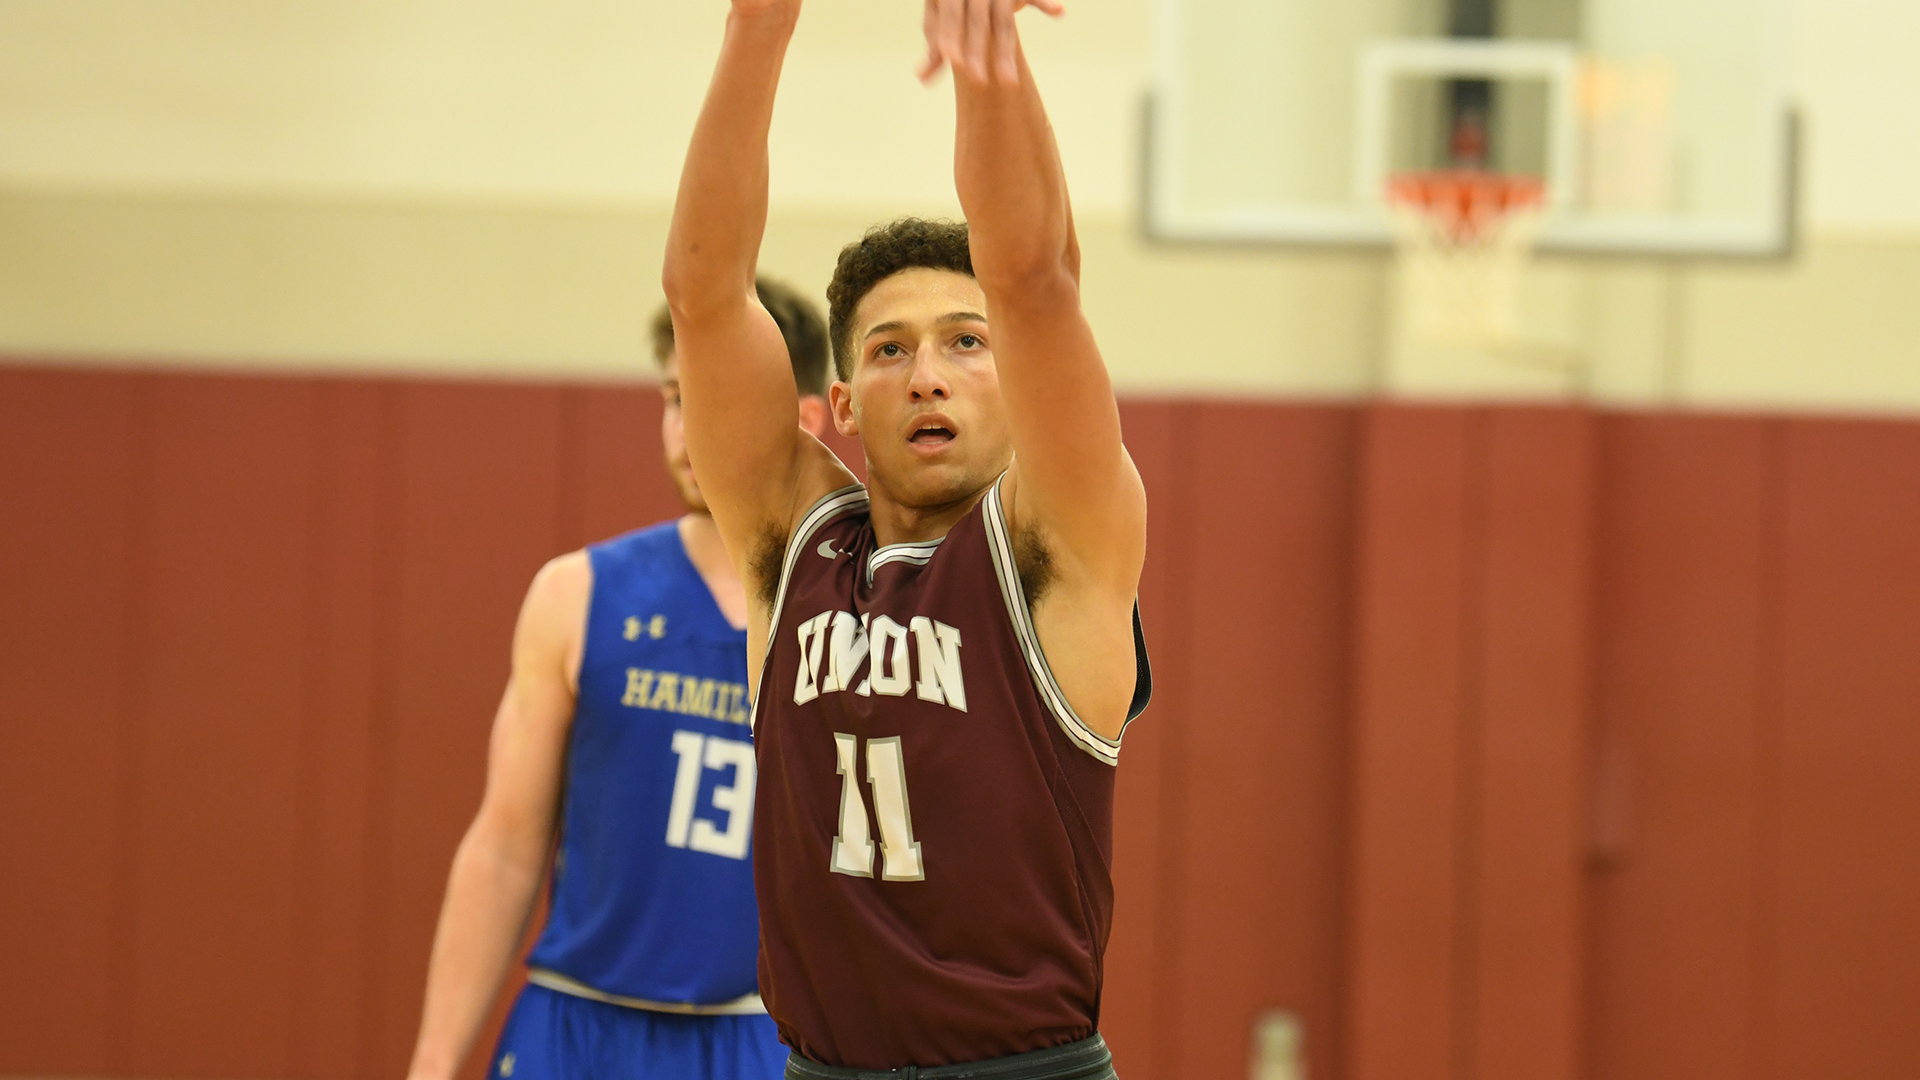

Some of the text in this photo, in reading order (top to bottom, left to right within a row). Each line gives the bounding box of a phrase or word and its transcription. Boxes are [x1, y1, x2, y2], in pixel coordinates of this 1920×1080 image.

[621, 666, 750, 726] HAMIL
[665, 729, 756, 860] 13
[830, 732, 925, 881] 11
